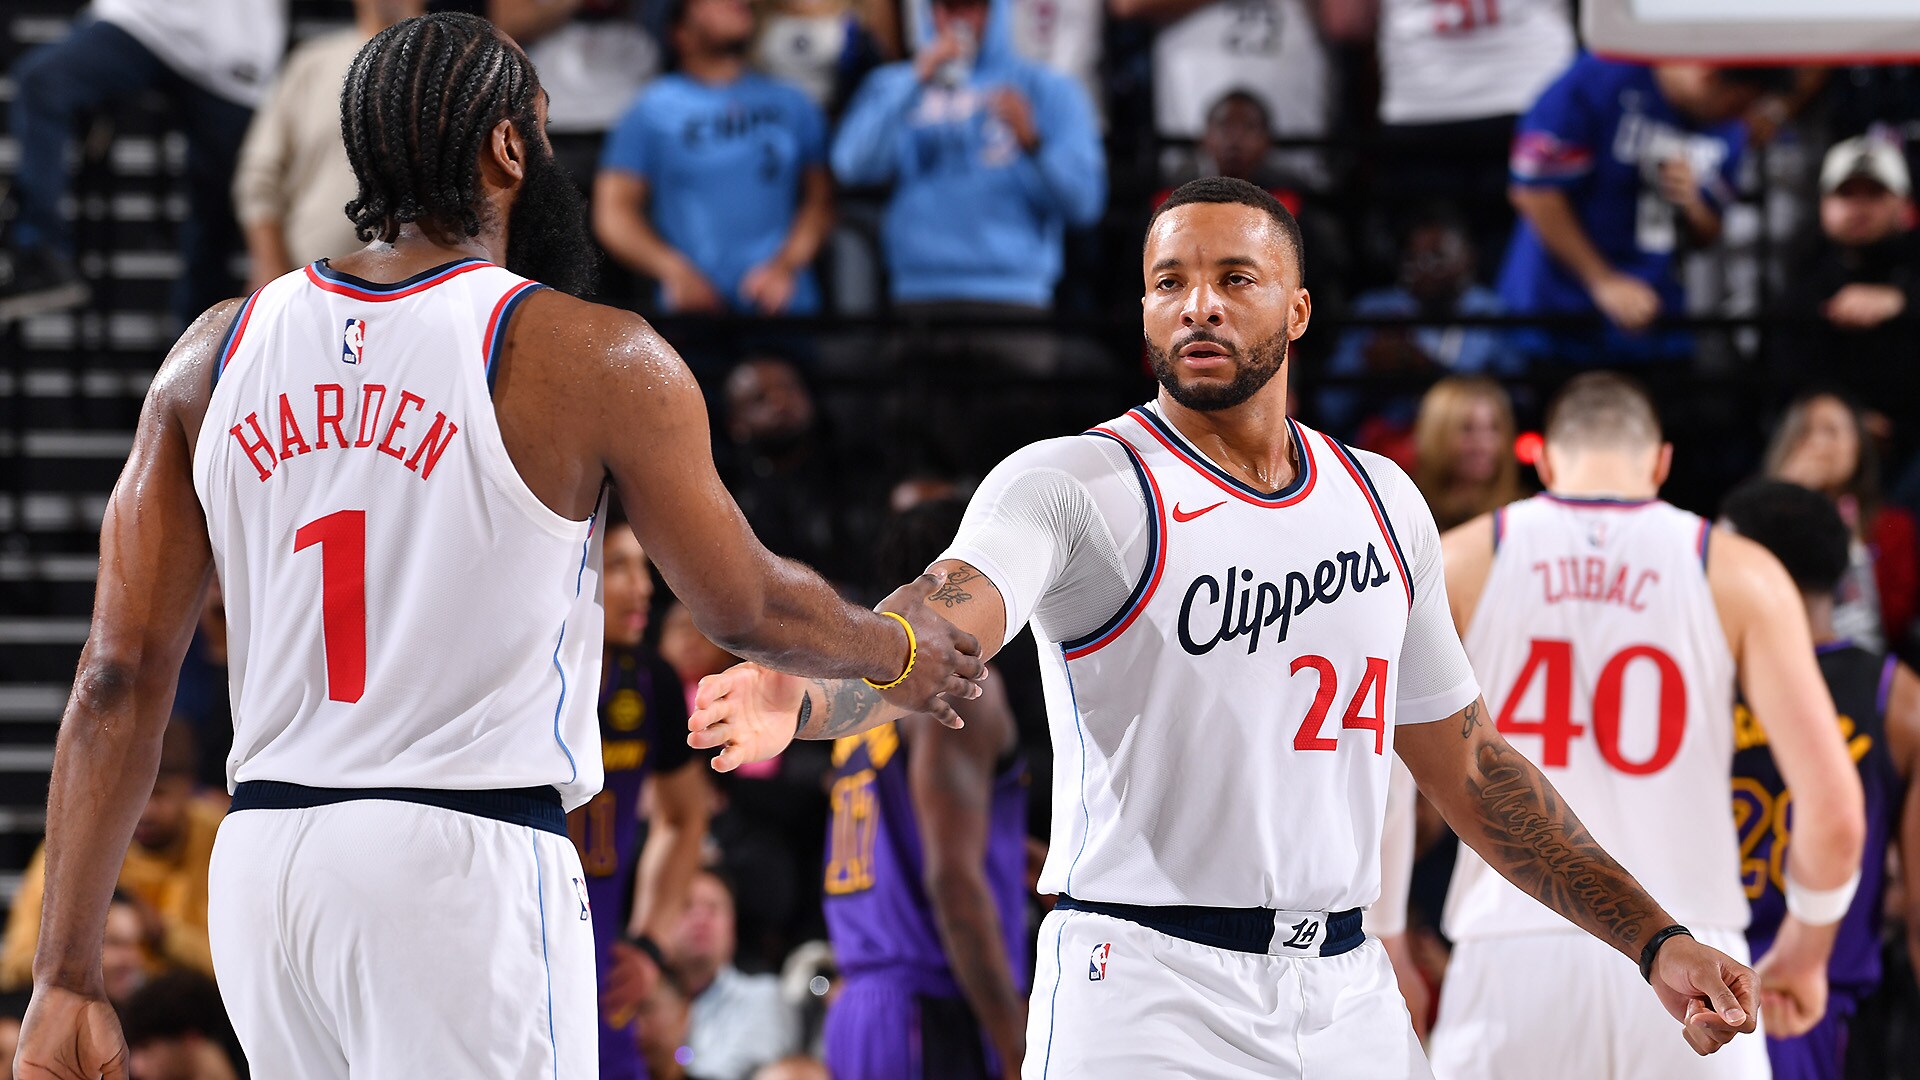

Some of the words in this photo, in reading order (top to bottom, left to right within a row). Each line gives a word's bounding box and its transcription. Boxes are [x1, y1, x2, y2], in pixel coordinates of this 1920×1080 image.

[229, 383, 458, 482] HARDEN
[293, 509, 367, 704] 1
[1176, 541, 1391, 656] Clippers
[1532, 556, 1660, 612] ZUBAC
[1289, 654, 1389, 756] 24
[1497, 639, 1688, 778] 40
[1480, 765, 1649, 944] Unshakeable
[1283, 917, 1319, 950] LA
